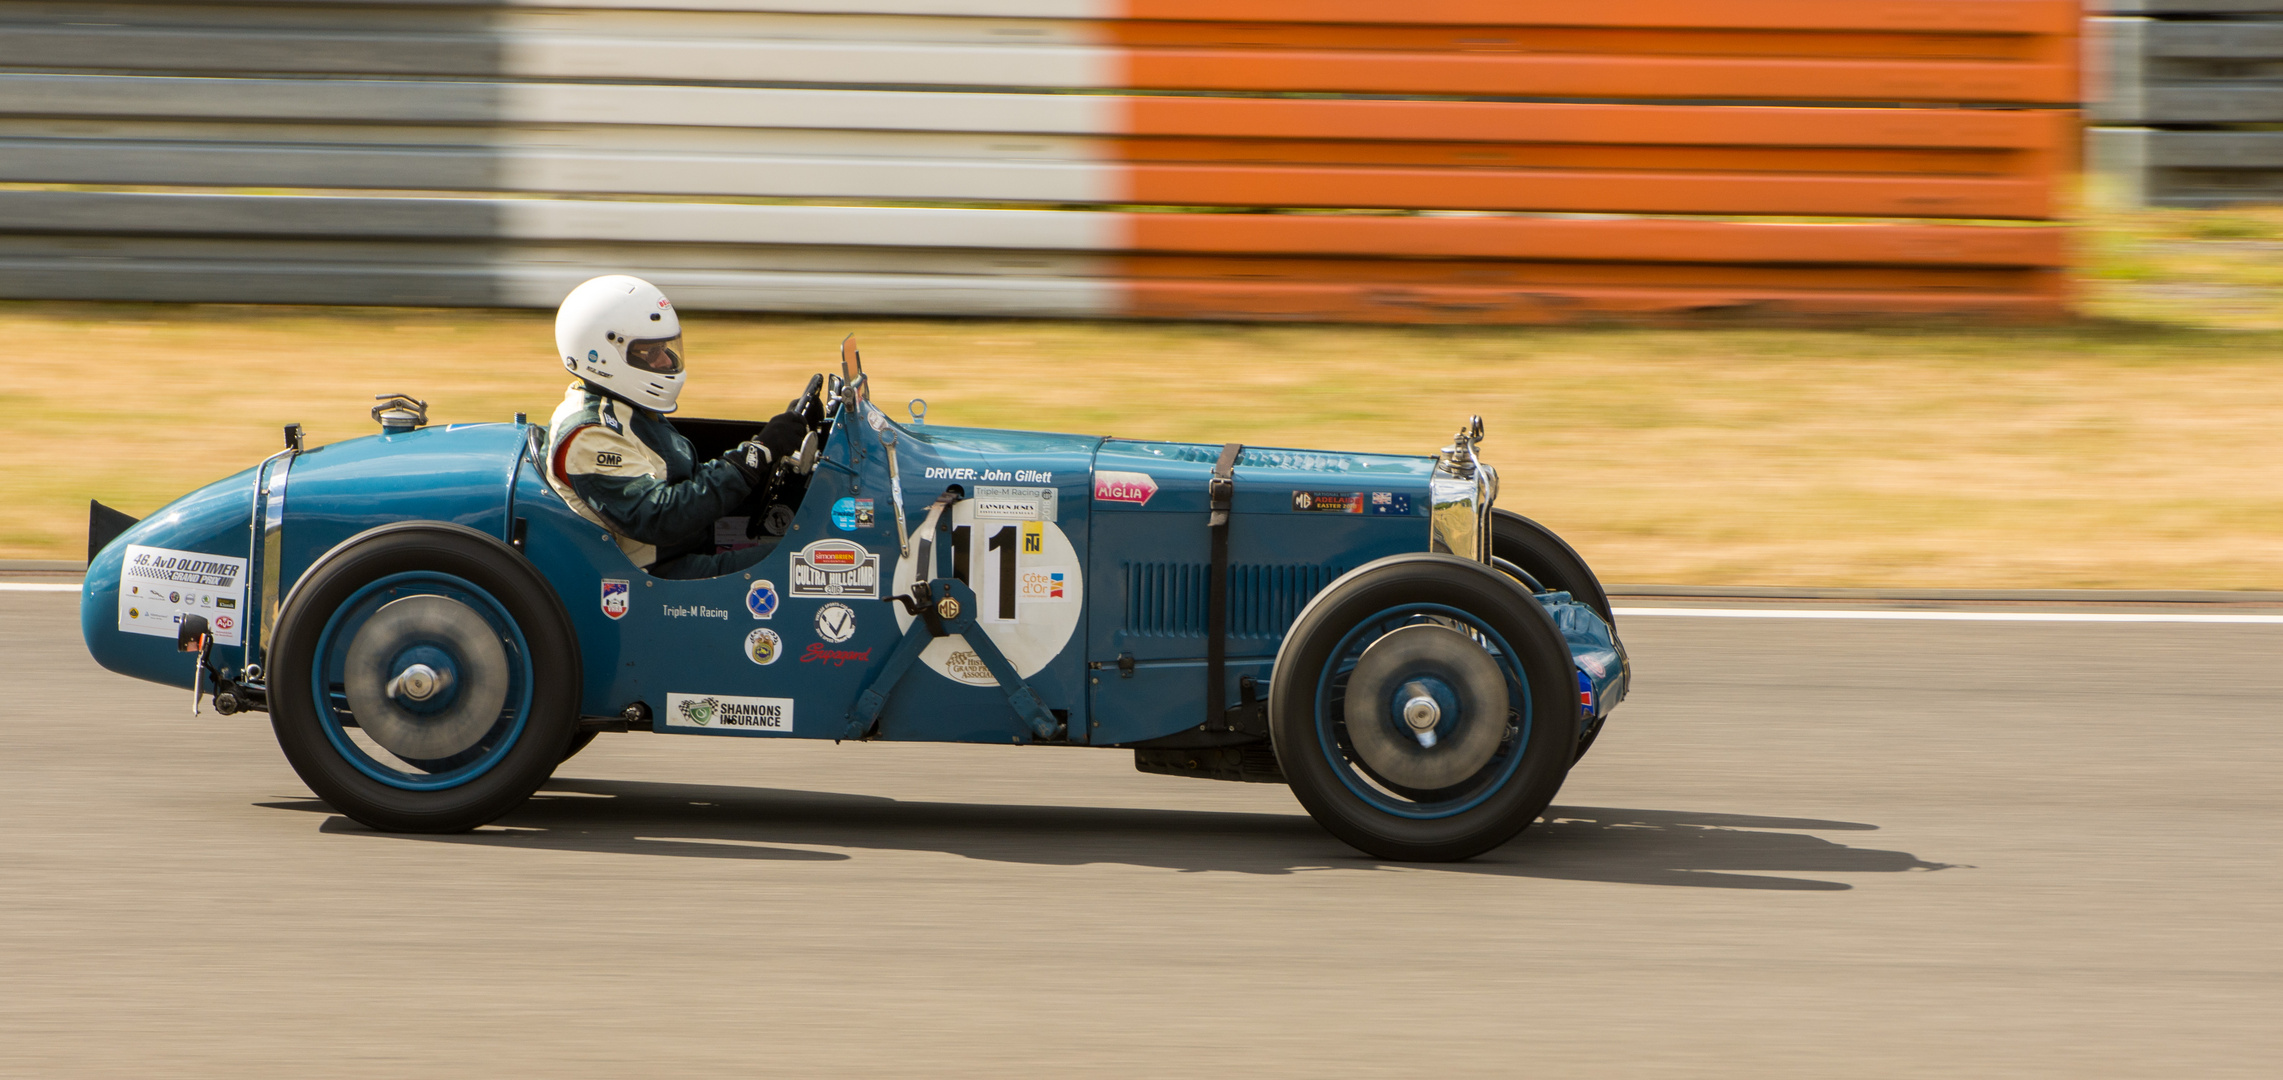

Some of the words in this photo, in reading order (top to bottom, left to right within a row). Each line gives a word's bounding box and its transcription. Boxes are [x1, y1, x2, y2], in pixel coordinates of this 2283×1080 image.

[597, 454, 622, 465] OMP
[925, 467, 978, 480] DRIVER:
[980, 469, 1011, 481] John
[1015, 469, 1052, 483] Gillett
[976, 487, 1009, 496] Triple-M
[1011, 488, 1040, 498] Racing
[1098, 486, 1142, 499] MIGLIA
[133, 554, 150, 566] 46.
[152, 555, 177, 569] AvD
[177, 558, 239, 577] OLDTIMER
[171, 571, 200, 583] GRAND
[200, 574, 221, 586] PRIX
[795, 564, 826, 586] CULTRA
[829, 565, 874, 586] HILLCLIMB
[1022, 572, 1049, 583] Côte
[1022, 581, 1048, 594] d'Or
[663, 604, 697, 619] Triple-M
[700, 605, 728, 620] Racing
[939, 598, 959, 618] MG
[720, 703, 781, 717] SHANNONS
[720, 714, 781, 727] INSURANCE
